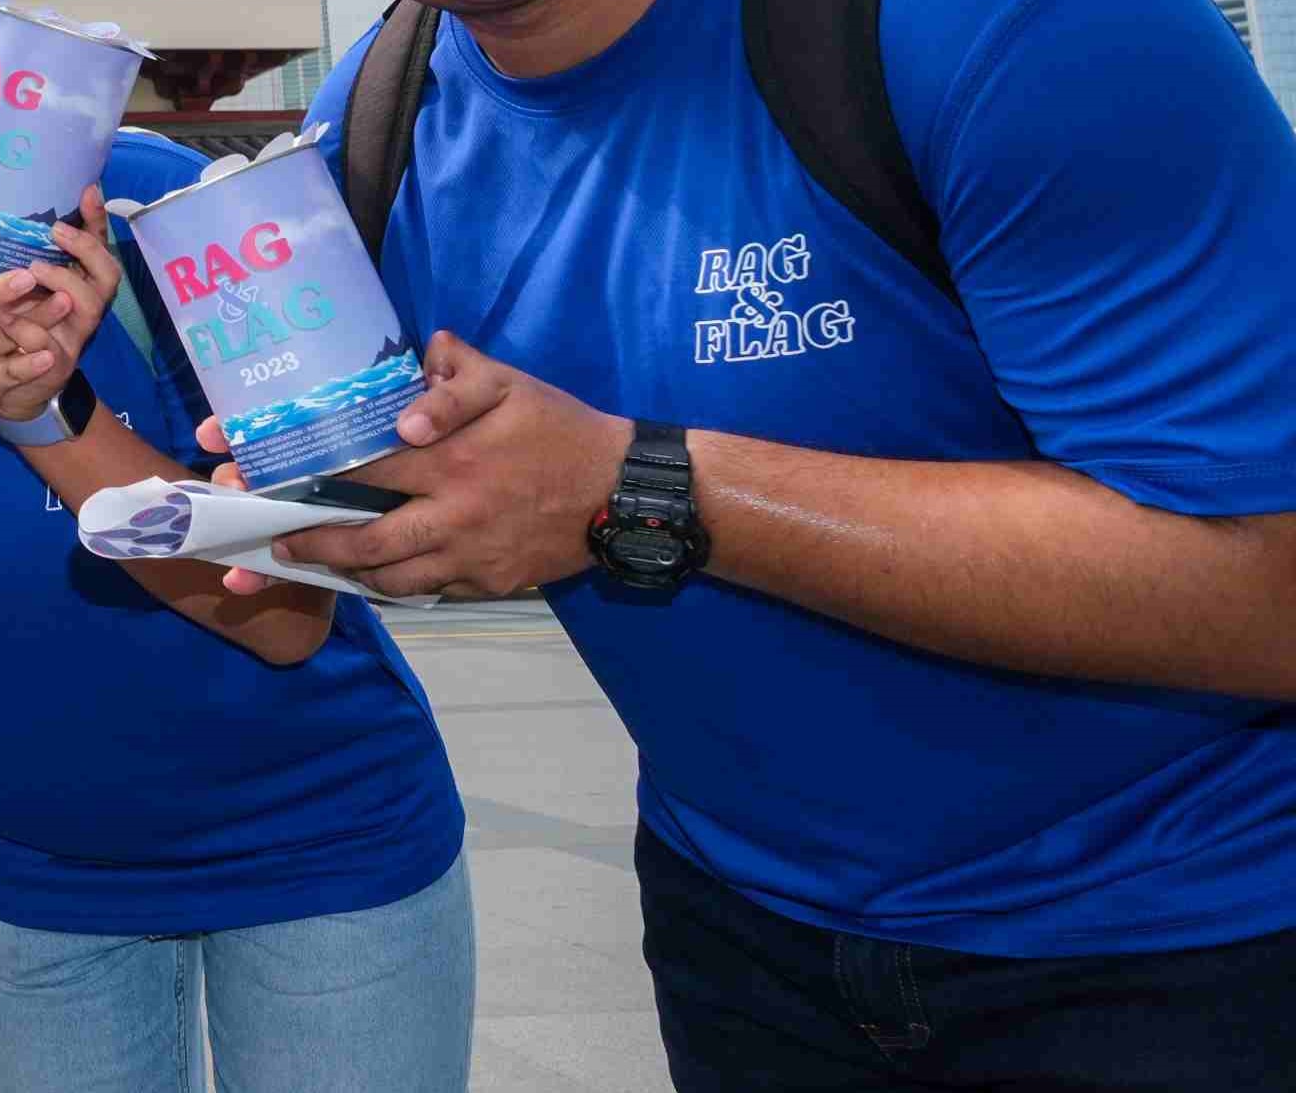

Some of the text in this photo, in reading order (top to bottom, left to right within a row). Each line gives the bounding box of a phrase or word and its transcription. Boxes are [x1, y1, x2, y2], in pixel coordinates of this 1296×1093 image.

[163, 221, 293, 306] RAG
[694, 233, 811, 294] RAG
[185, 280, 336, 369] FLAG
[216, 276, 258, 323] &
[730, 282, 784, 328] &
[694, 300, 856, 364] FLAG
[240, 352, 300, 388] 2023
